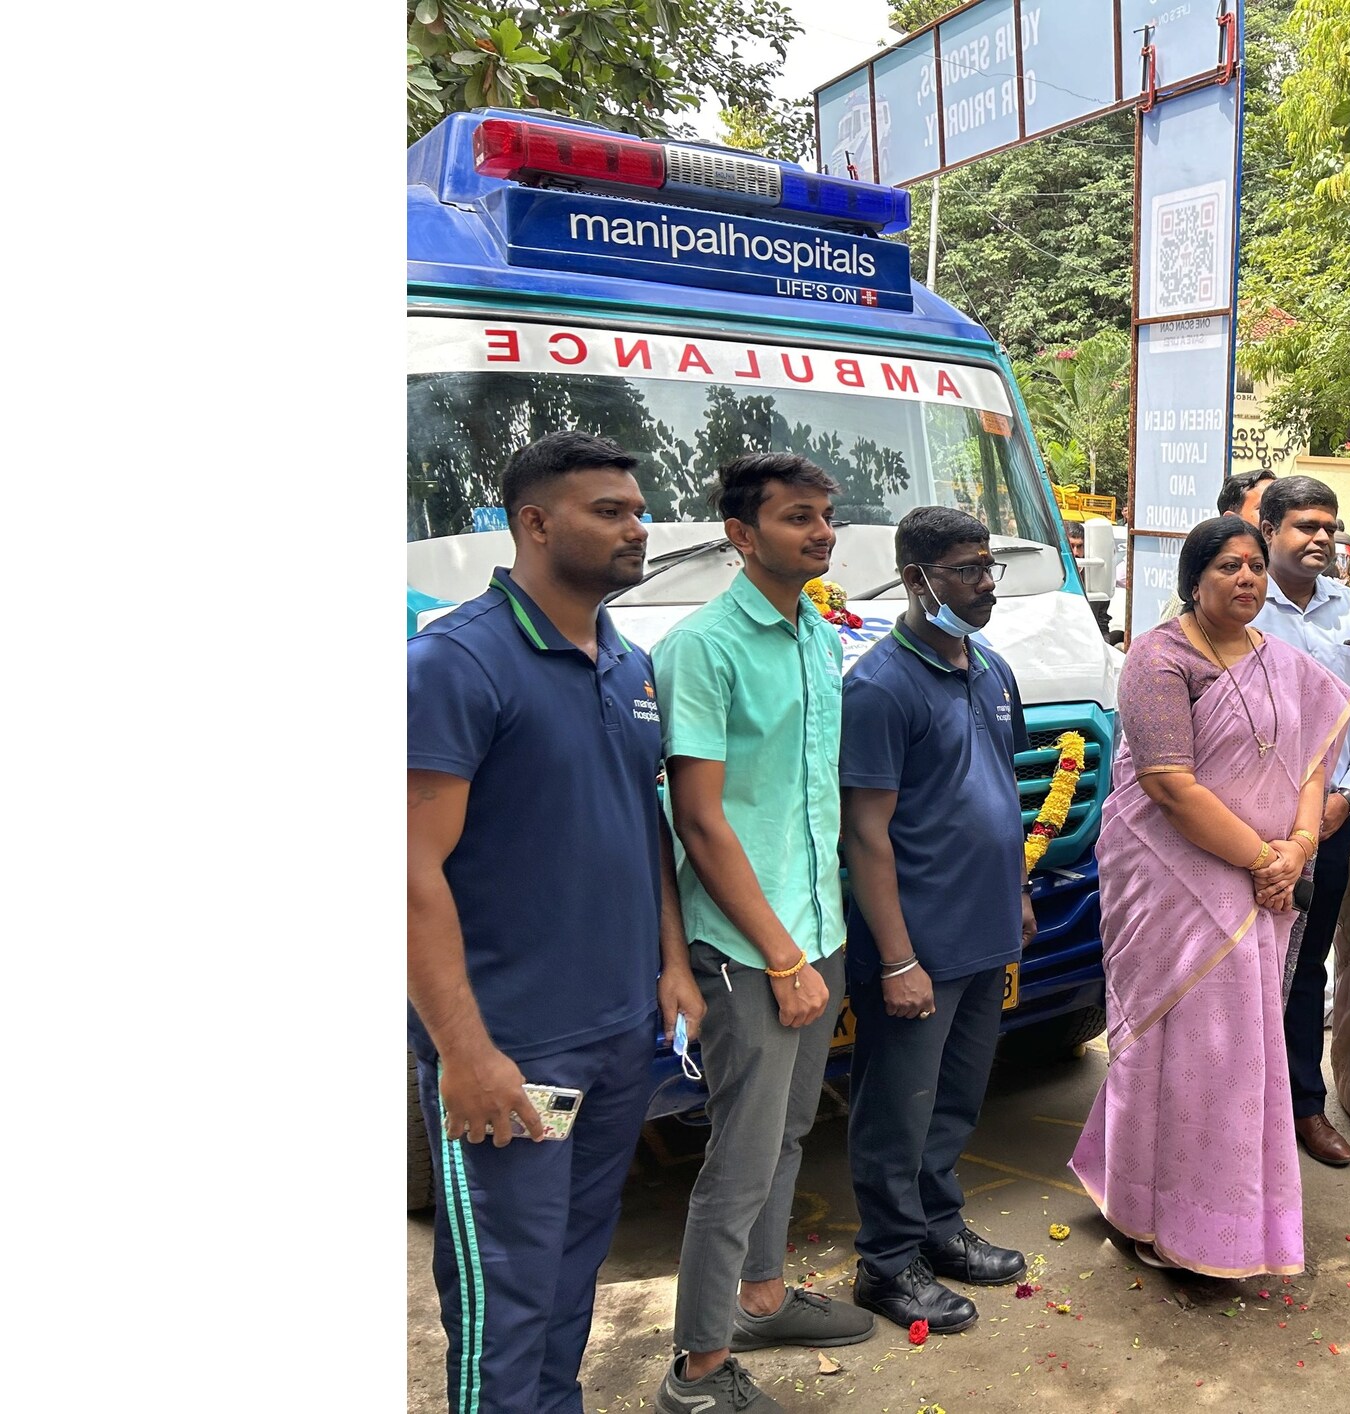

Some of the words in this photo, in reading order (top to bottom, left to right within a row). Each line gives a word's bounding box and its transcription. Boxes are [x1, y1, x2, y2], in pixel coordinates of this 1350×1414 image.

[569, 213, 877, 278] manipalhospitals
[776, 278, 829, 301] LIFE'S
[831, 286, 858, 305] ON
[1233, 393, 1258, 402] OBHA
